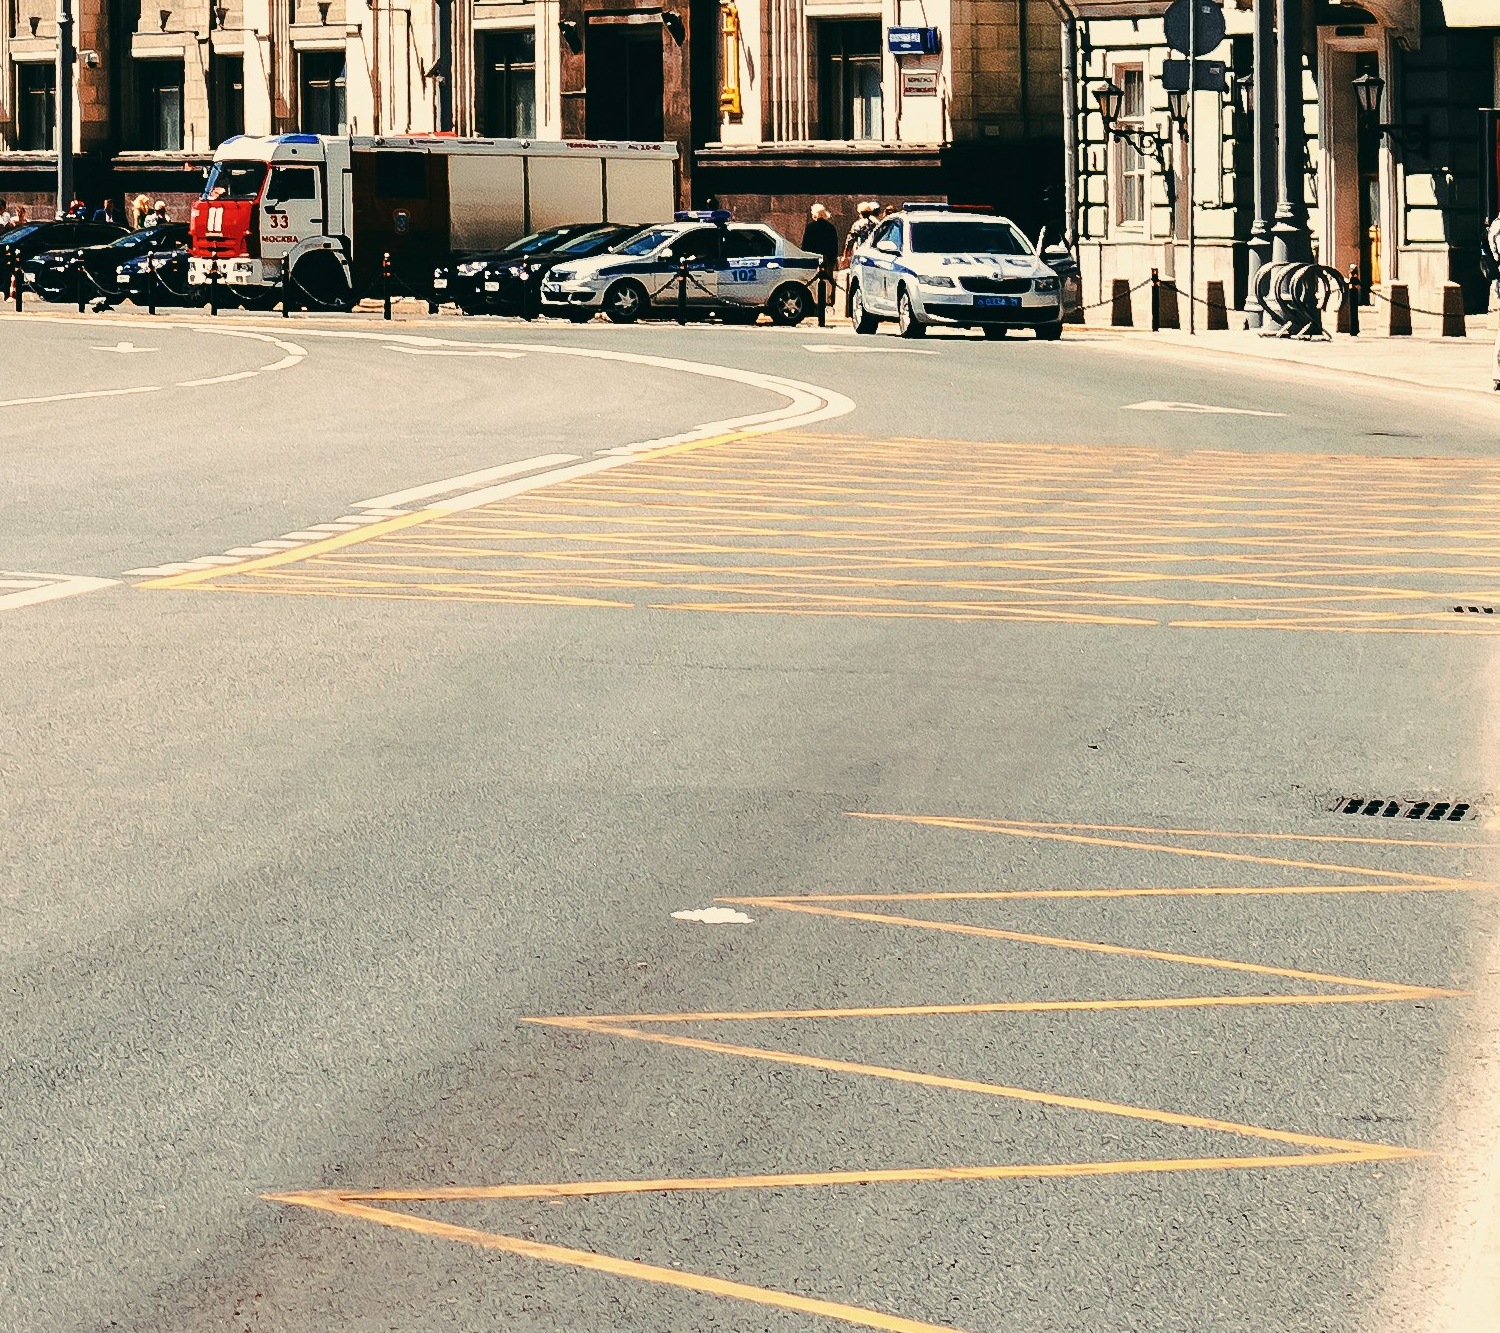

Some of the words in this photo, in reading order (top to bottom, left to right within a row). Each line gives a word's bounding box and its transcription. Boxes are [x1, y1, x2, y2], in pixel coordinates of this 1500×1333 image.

[270, 214, 289, 229] 33
[261, 235, 299, 243] МОСКВА
[731, 268, 757, 282] 102
